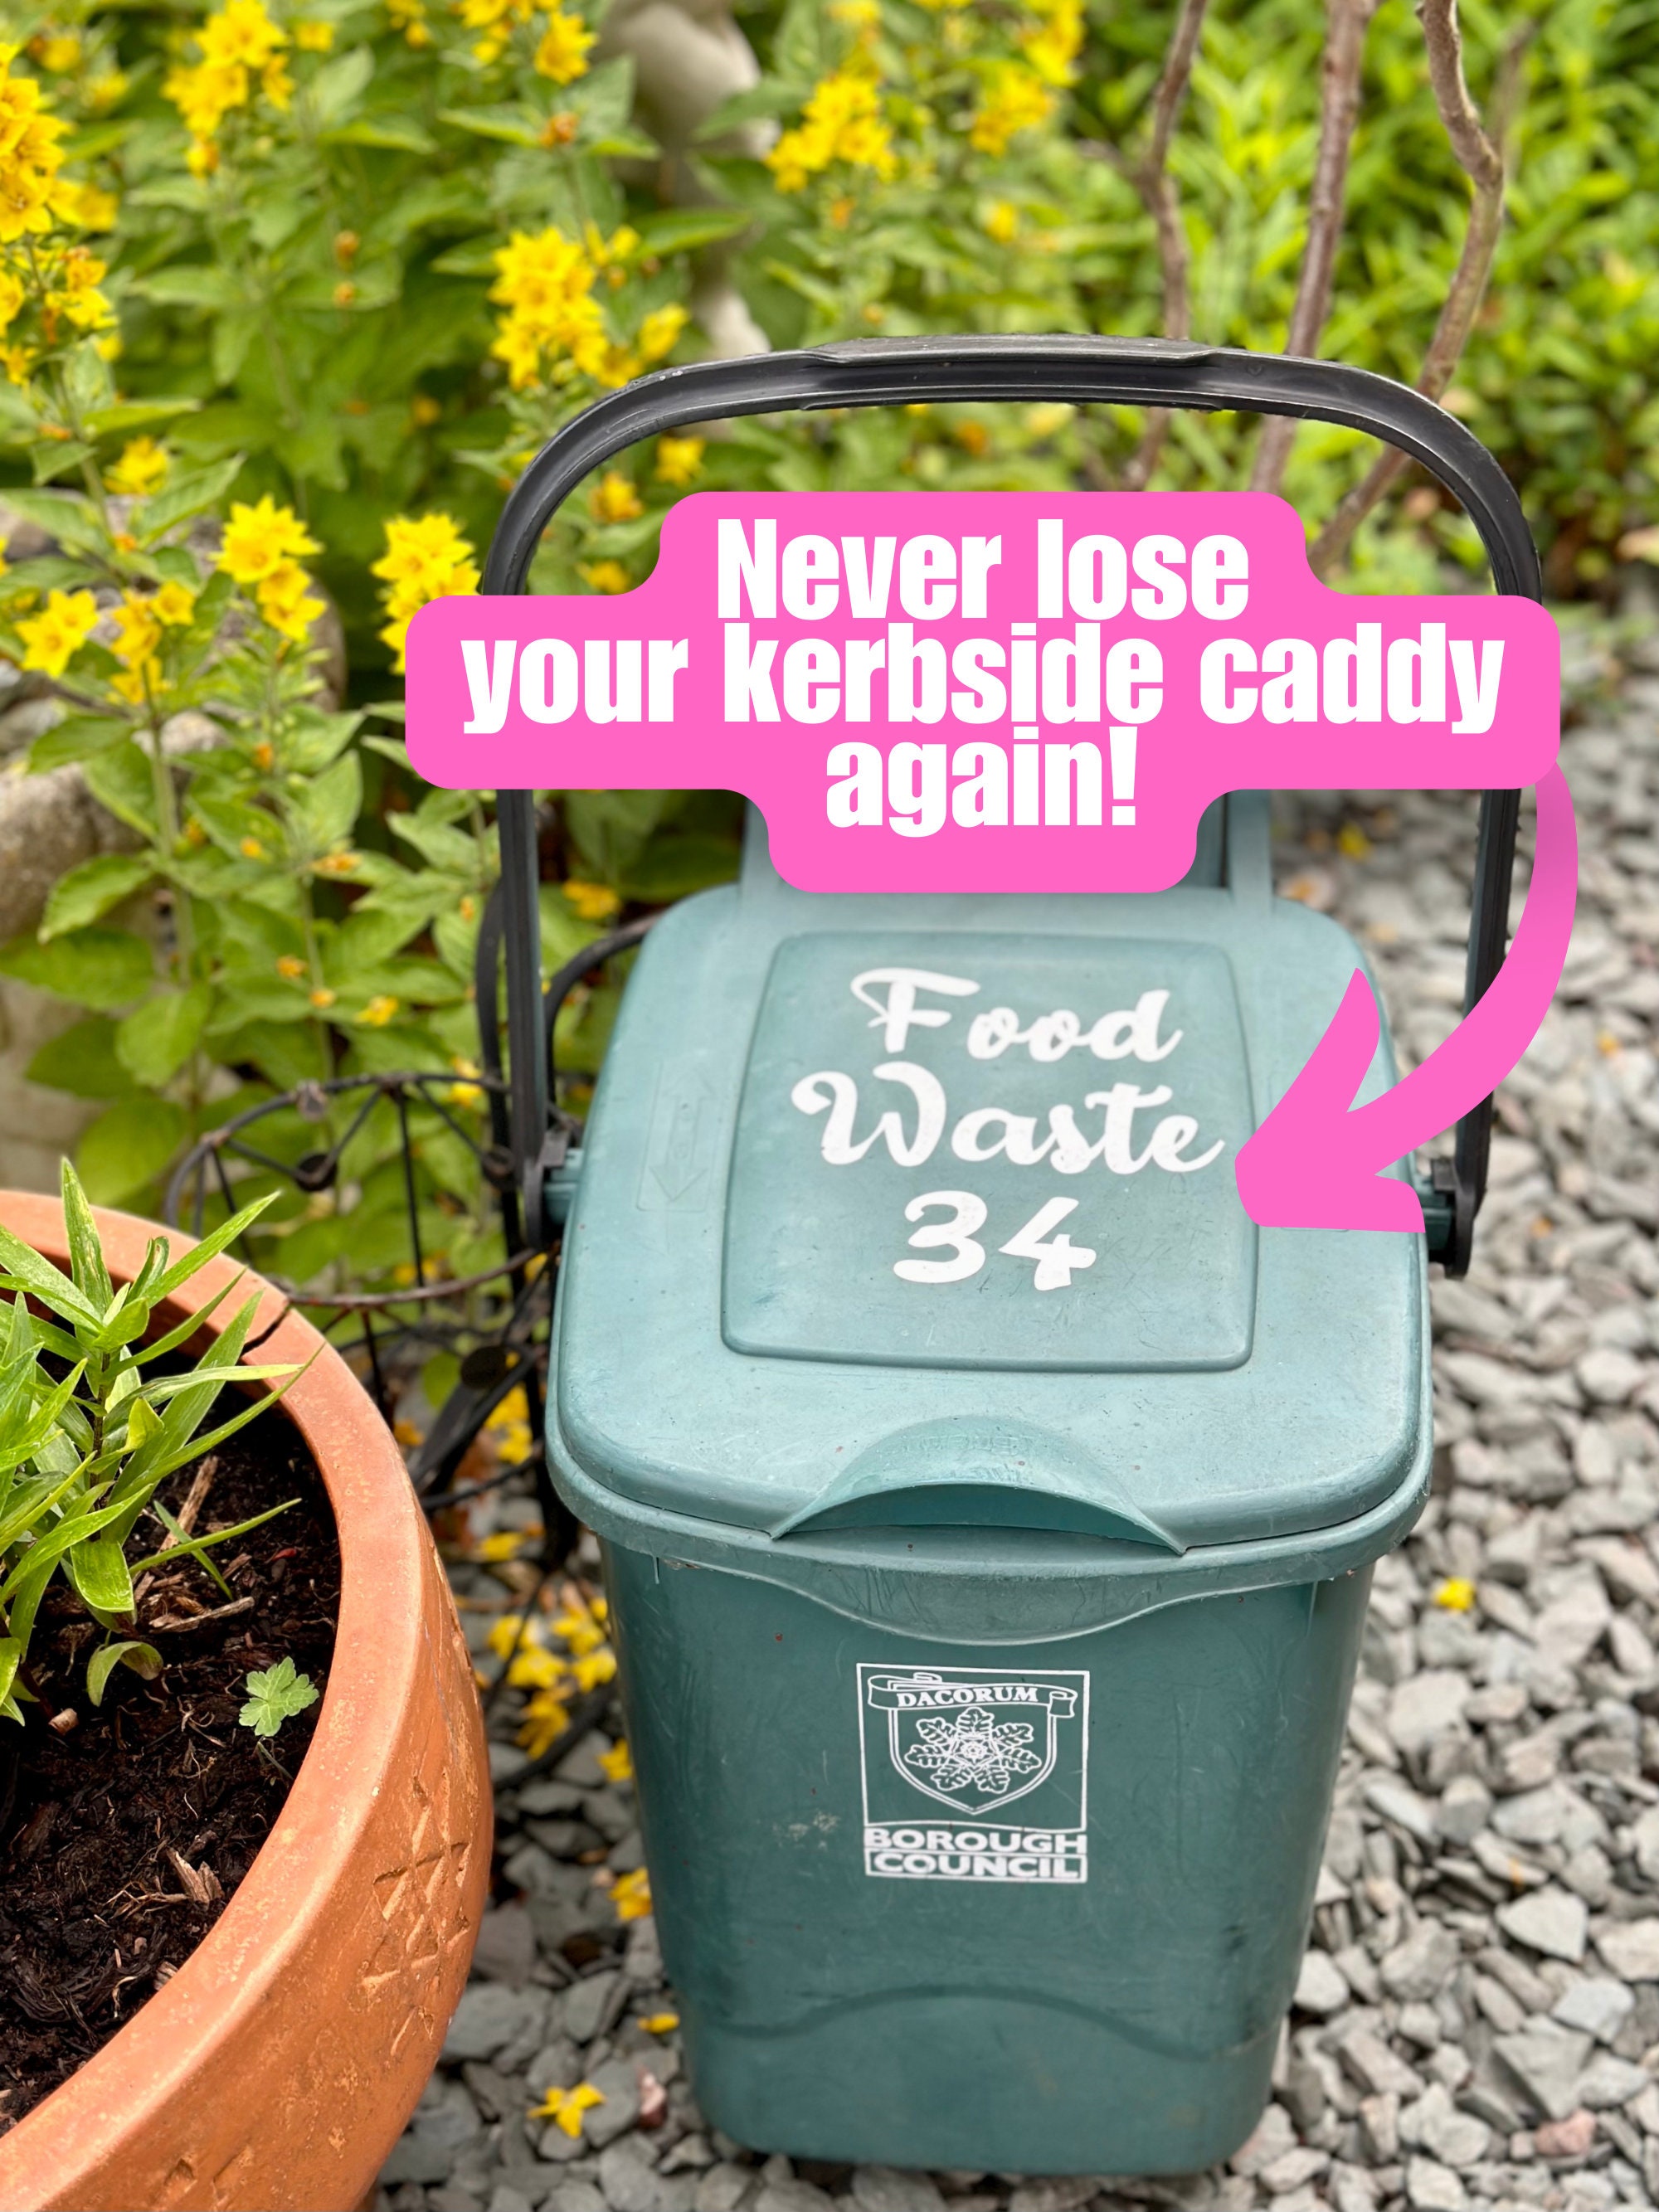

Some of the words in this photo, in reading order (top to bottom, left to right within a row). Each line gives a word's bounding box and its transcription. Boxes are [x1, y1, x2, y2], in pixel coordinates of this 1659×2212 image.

[850, 968, 1183, 1062] Food
[791, 1061, 1226, 1175] Waste
[893, 1189, 1097, 1291] 34
[897, 1686, 1039, 1708] DACORUM
[864, 1827, 1087, 1855] BOROUGH
[873, 1853, 1080, 1879] COUNCIL
